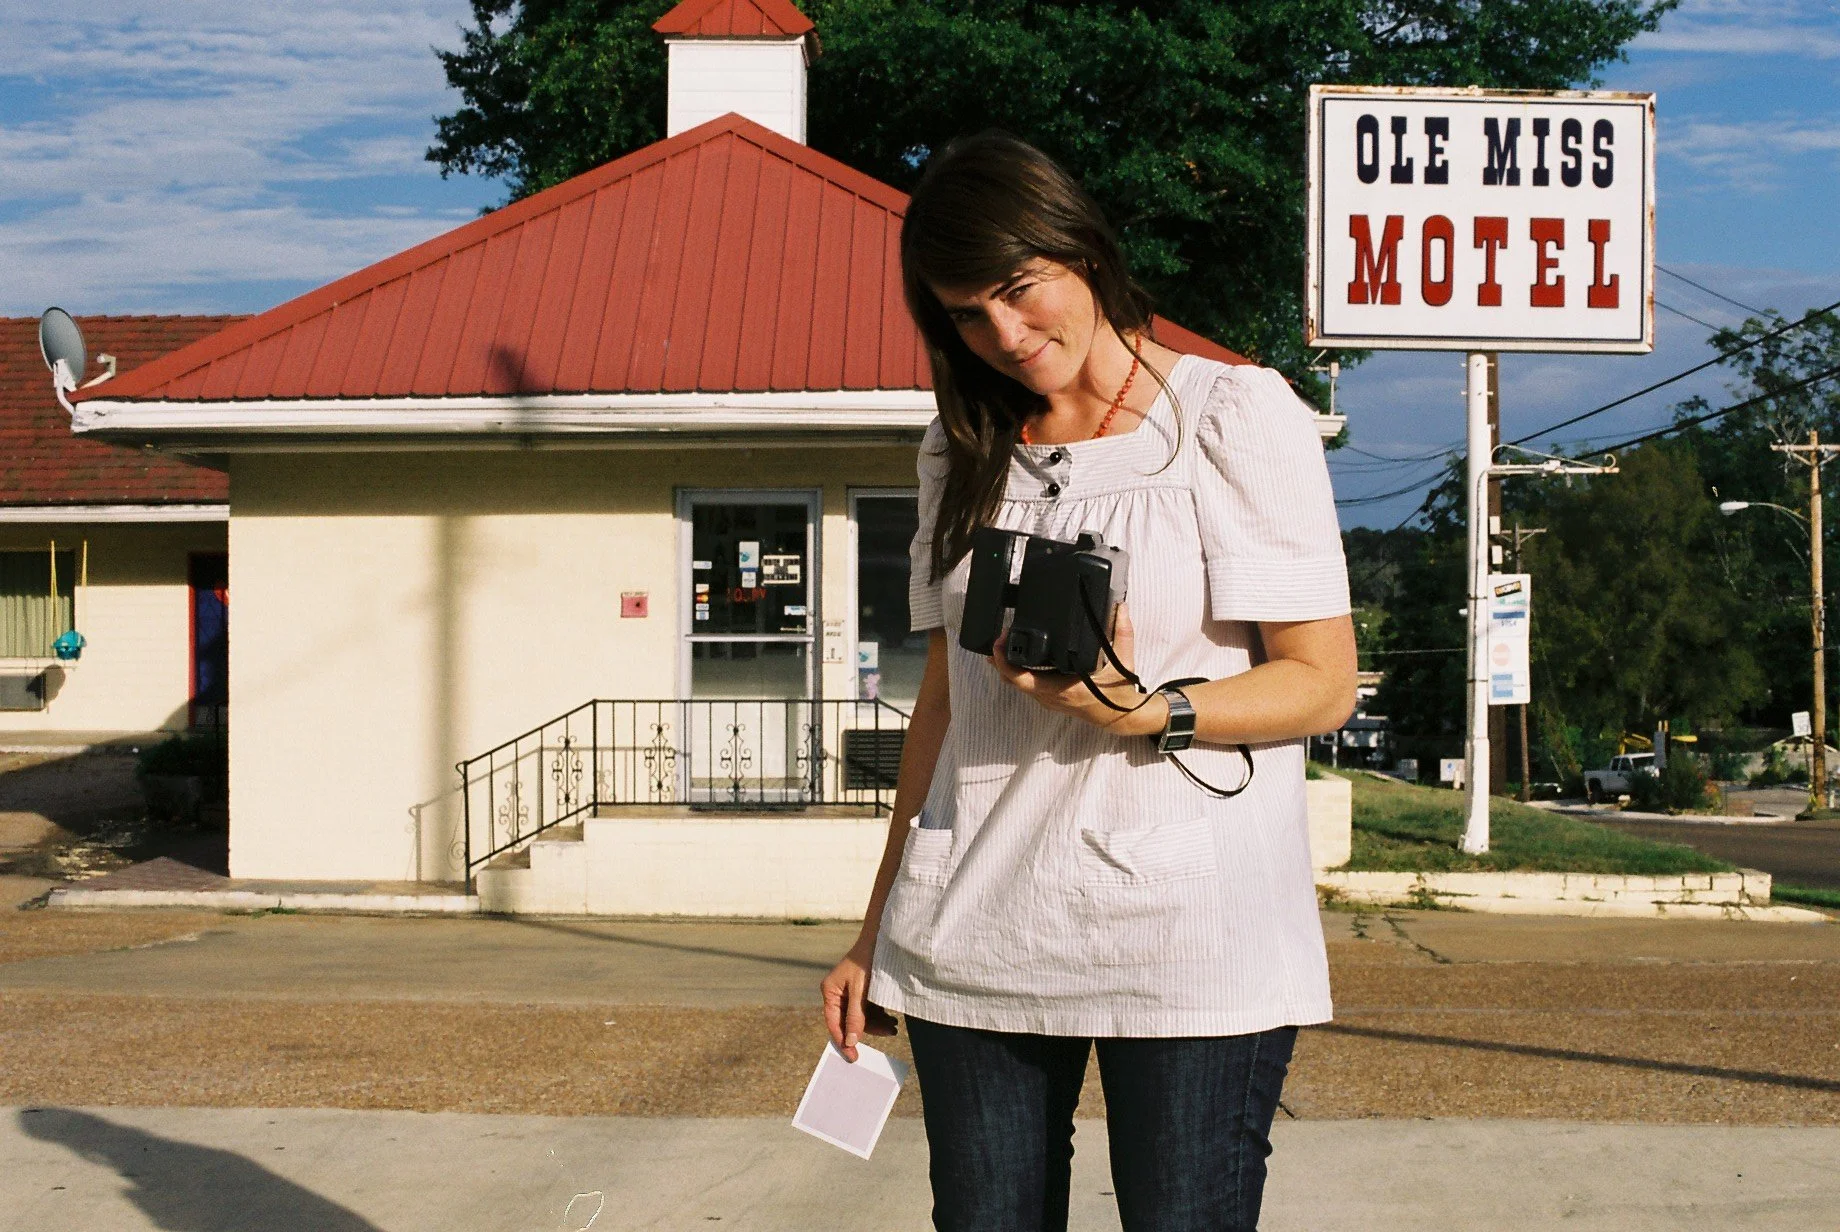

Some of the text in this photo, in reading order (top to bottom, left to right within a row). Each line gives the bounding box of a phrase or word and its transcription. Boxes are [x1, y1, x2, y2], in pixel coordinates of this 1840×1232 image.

[1356, 114, 1614, 188] OLE MISS
[1347, 214, 1620, 309] MOTEL
